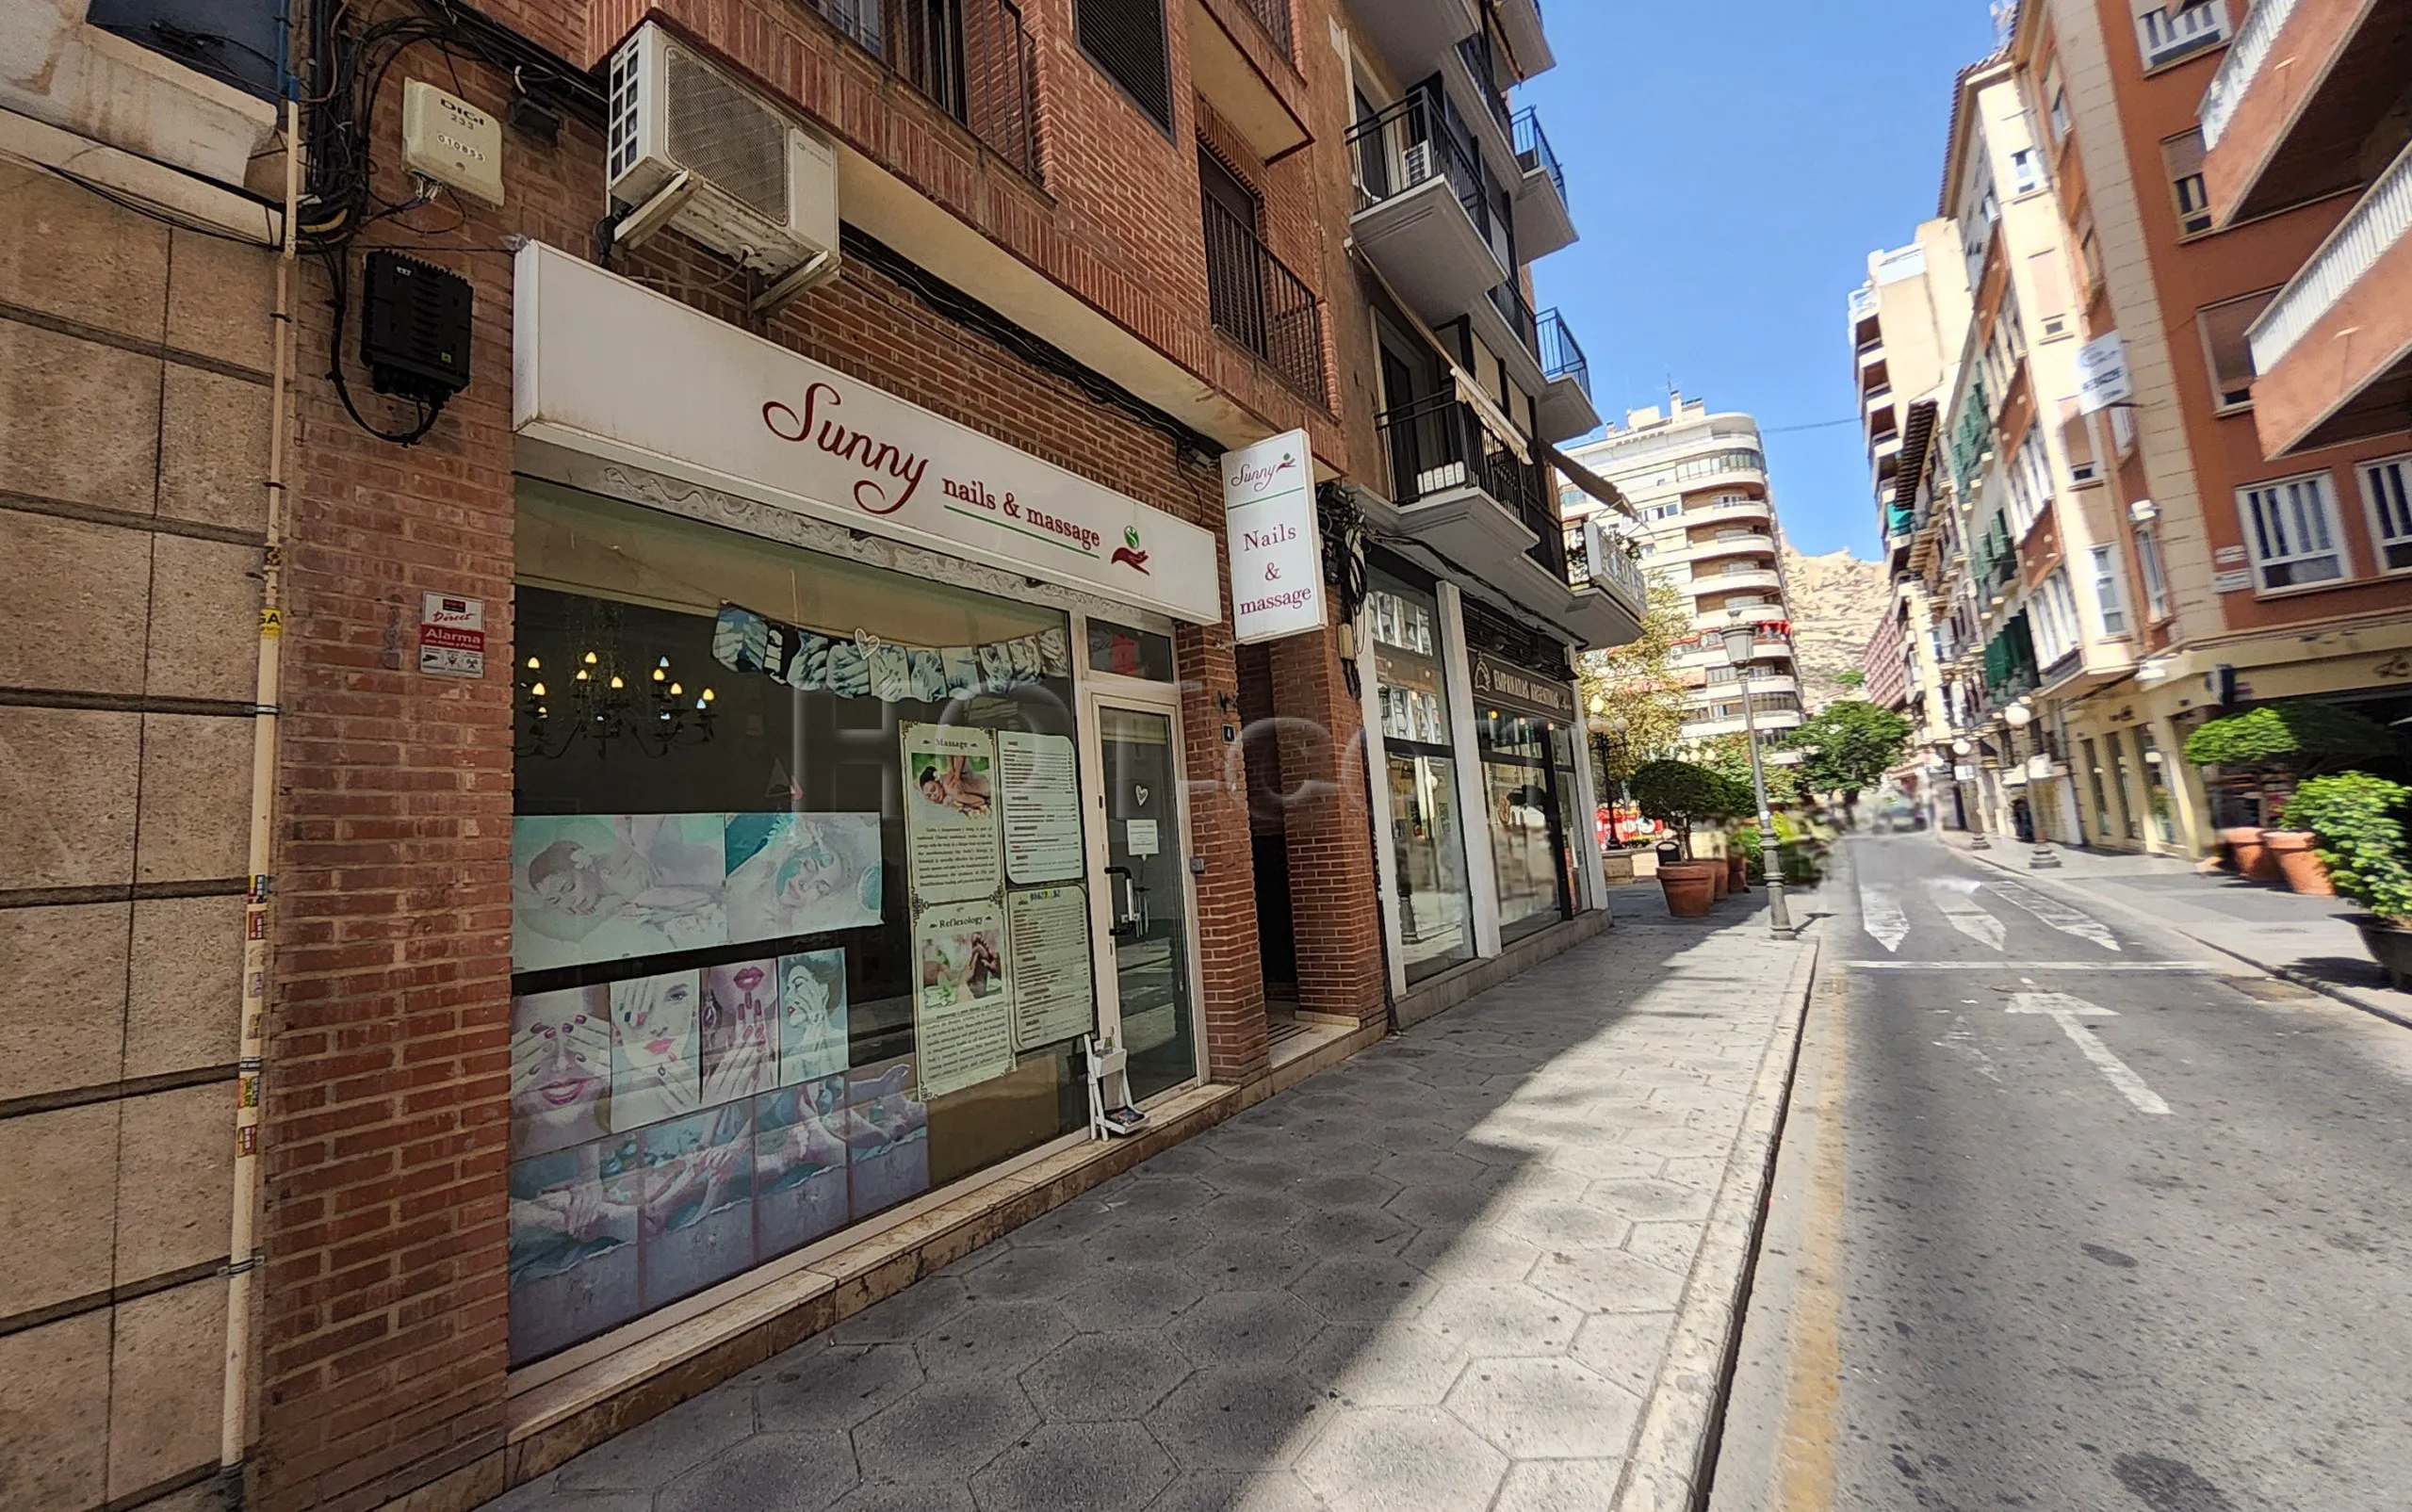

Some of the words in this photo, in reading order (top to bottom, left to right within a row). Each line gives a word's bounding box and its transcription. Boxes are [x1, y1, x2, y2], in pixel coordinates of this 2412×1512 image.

[440, 98, 485, 126] DIGI
[450, 114, 475, 131] 233
[761, 382, 930, 515] Sunny
[941, 477, 998, 512] nails
[1002, 492, 1022, 519] &
[1026, 506, 1100, 550] massage
[1230, 461, 1278, 494] Sunny
[1242, 523, 1297, 553] Nails
[1263, 561, 1282, 582] &
[1239, 587, 1312, 616] massage
[425, 627, 481, 644] Alarma
[935, 737, 969, 750] Massage
[938, 915, 985, 930] Reflexology
